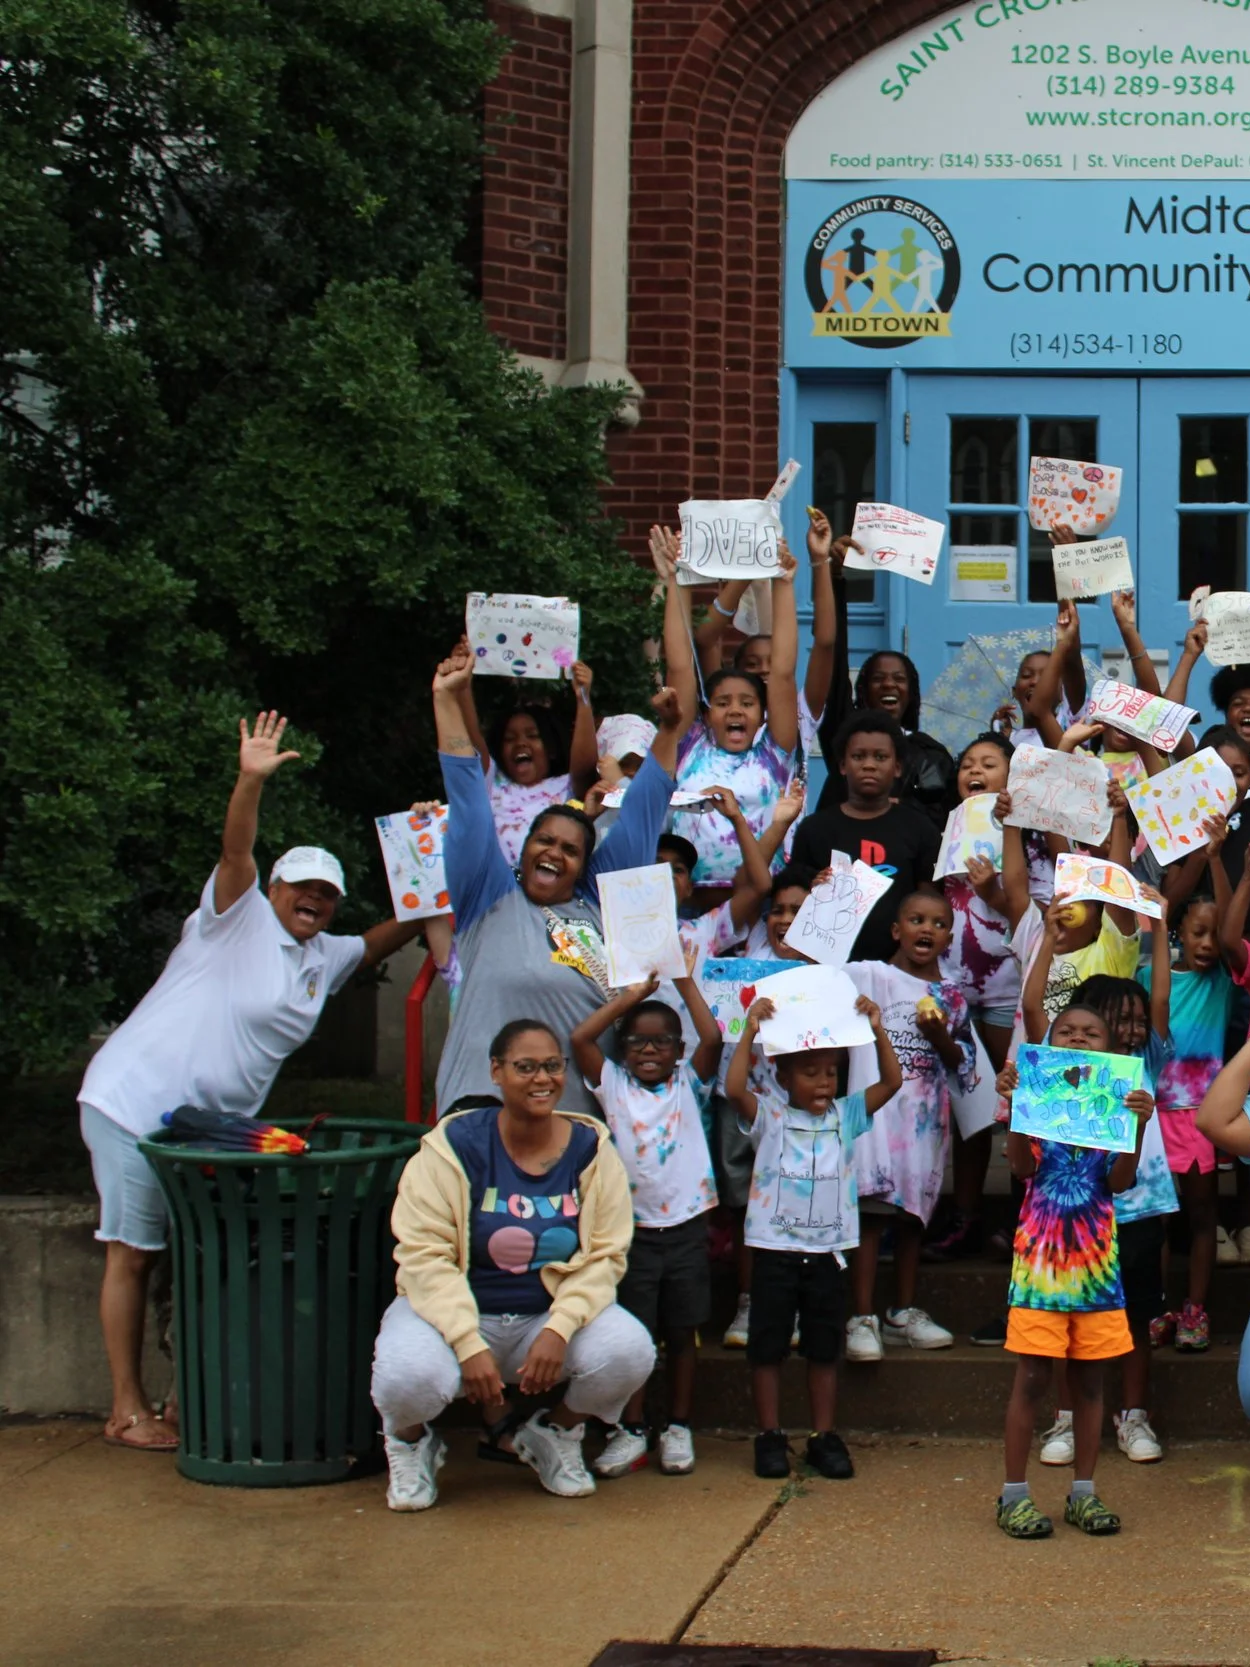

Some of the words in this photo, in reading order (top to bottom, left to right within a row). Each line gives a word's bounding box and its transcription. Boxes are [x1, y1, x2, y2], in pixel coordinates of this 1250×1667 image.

[880, 18, 965, 101] SAINT
[1010, 44, 1071, 64] 1202
[1077, 44, 1097, 64] S.
[1106, 44, 1174, 70] Boyle
[1046, 75, 1106, 97] (314)
[1113, 75, 1235, 96] 289-9384
[830, 153, 873, 168] Food
[876, 154, 935, 170] pantry:
[939, 153, 980, 169] (314)
[984, 153, 1063, 168] 533-0651
[1087, 153, 1109, 168] St.
[1113, 153, 1176, 168] Vincent
[1181, 153, 1244, 168] DePaul:
[813, 198, 890, 250] COMMUNITY
[893, 199, 953, 250] SERVICES
[825, 317, 939, 332] MIDTOWN
[1010, 333, 1183, 358] (314)534-1180
